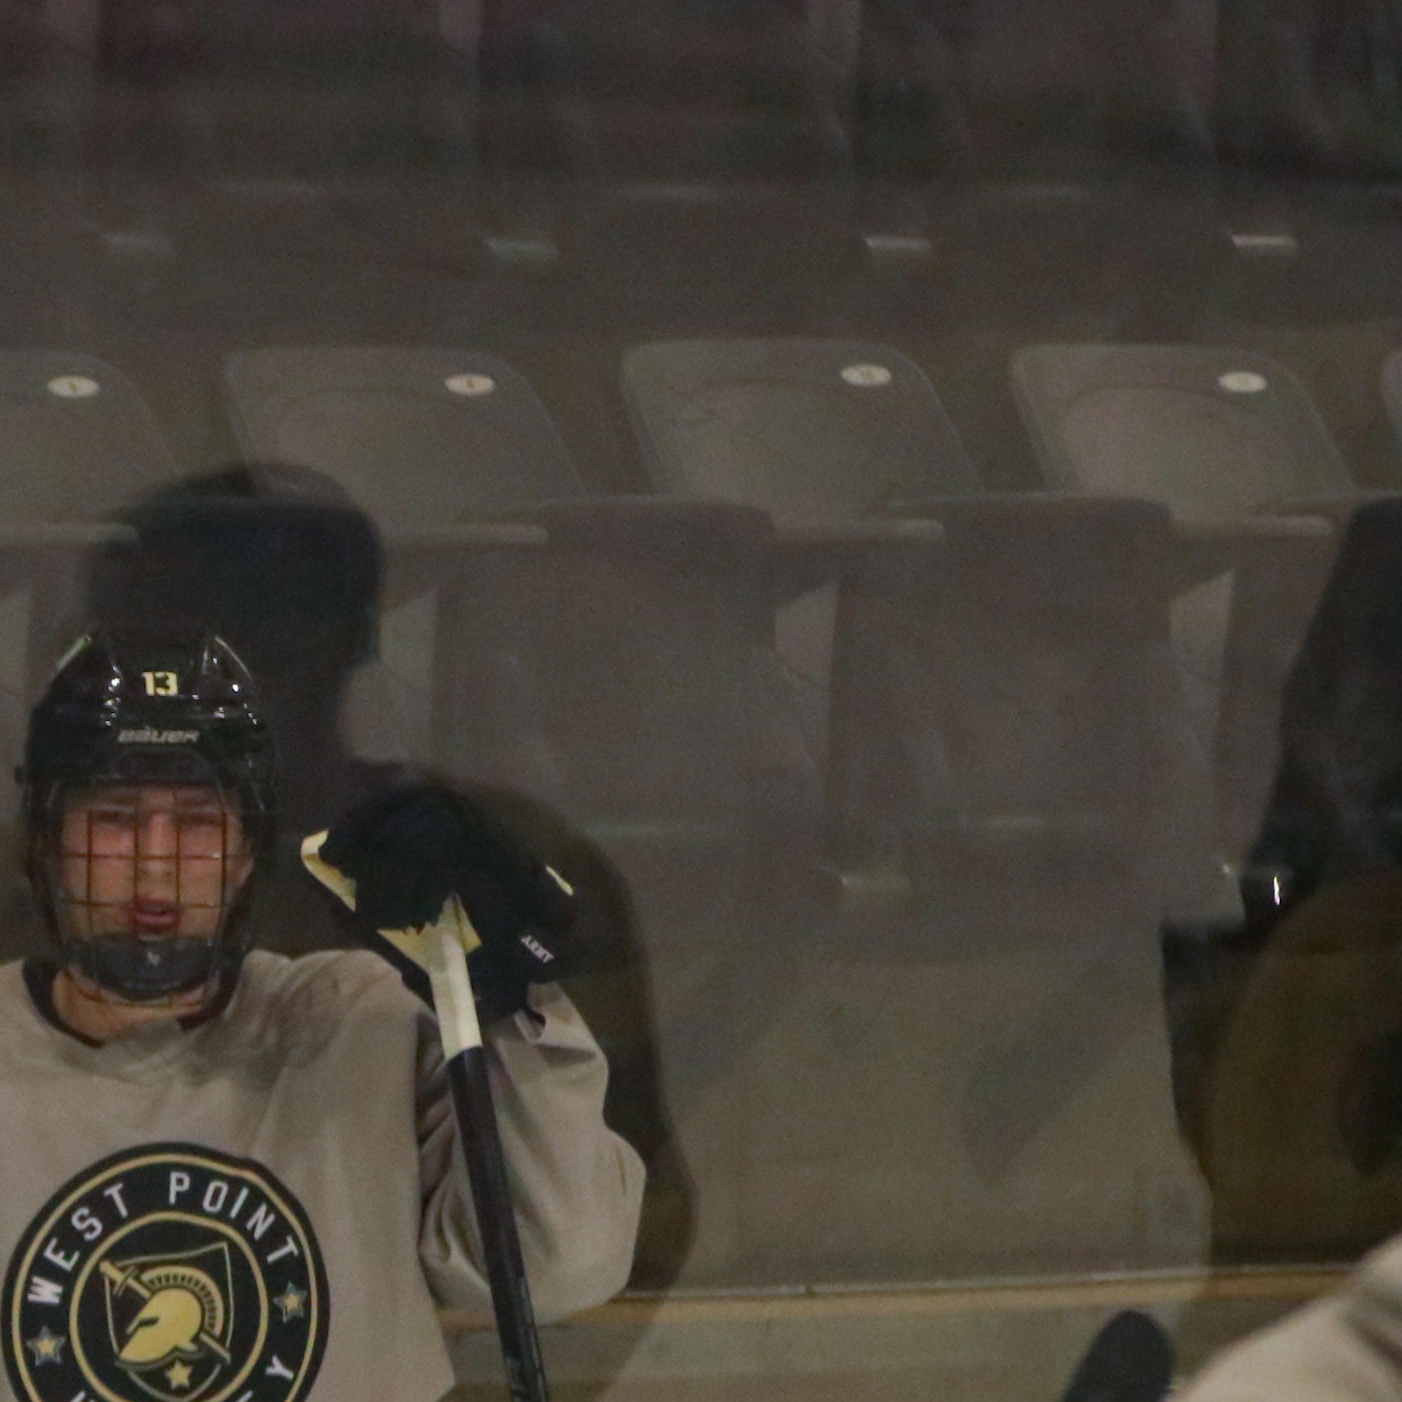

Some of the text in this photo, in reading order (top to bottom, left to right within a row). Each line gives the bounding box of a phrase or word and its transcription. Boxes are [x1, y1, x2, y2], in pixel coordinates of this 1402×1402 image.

[142, 671, 179, 697] 13
[28, 1171, 300, 1305] WEST POINT
